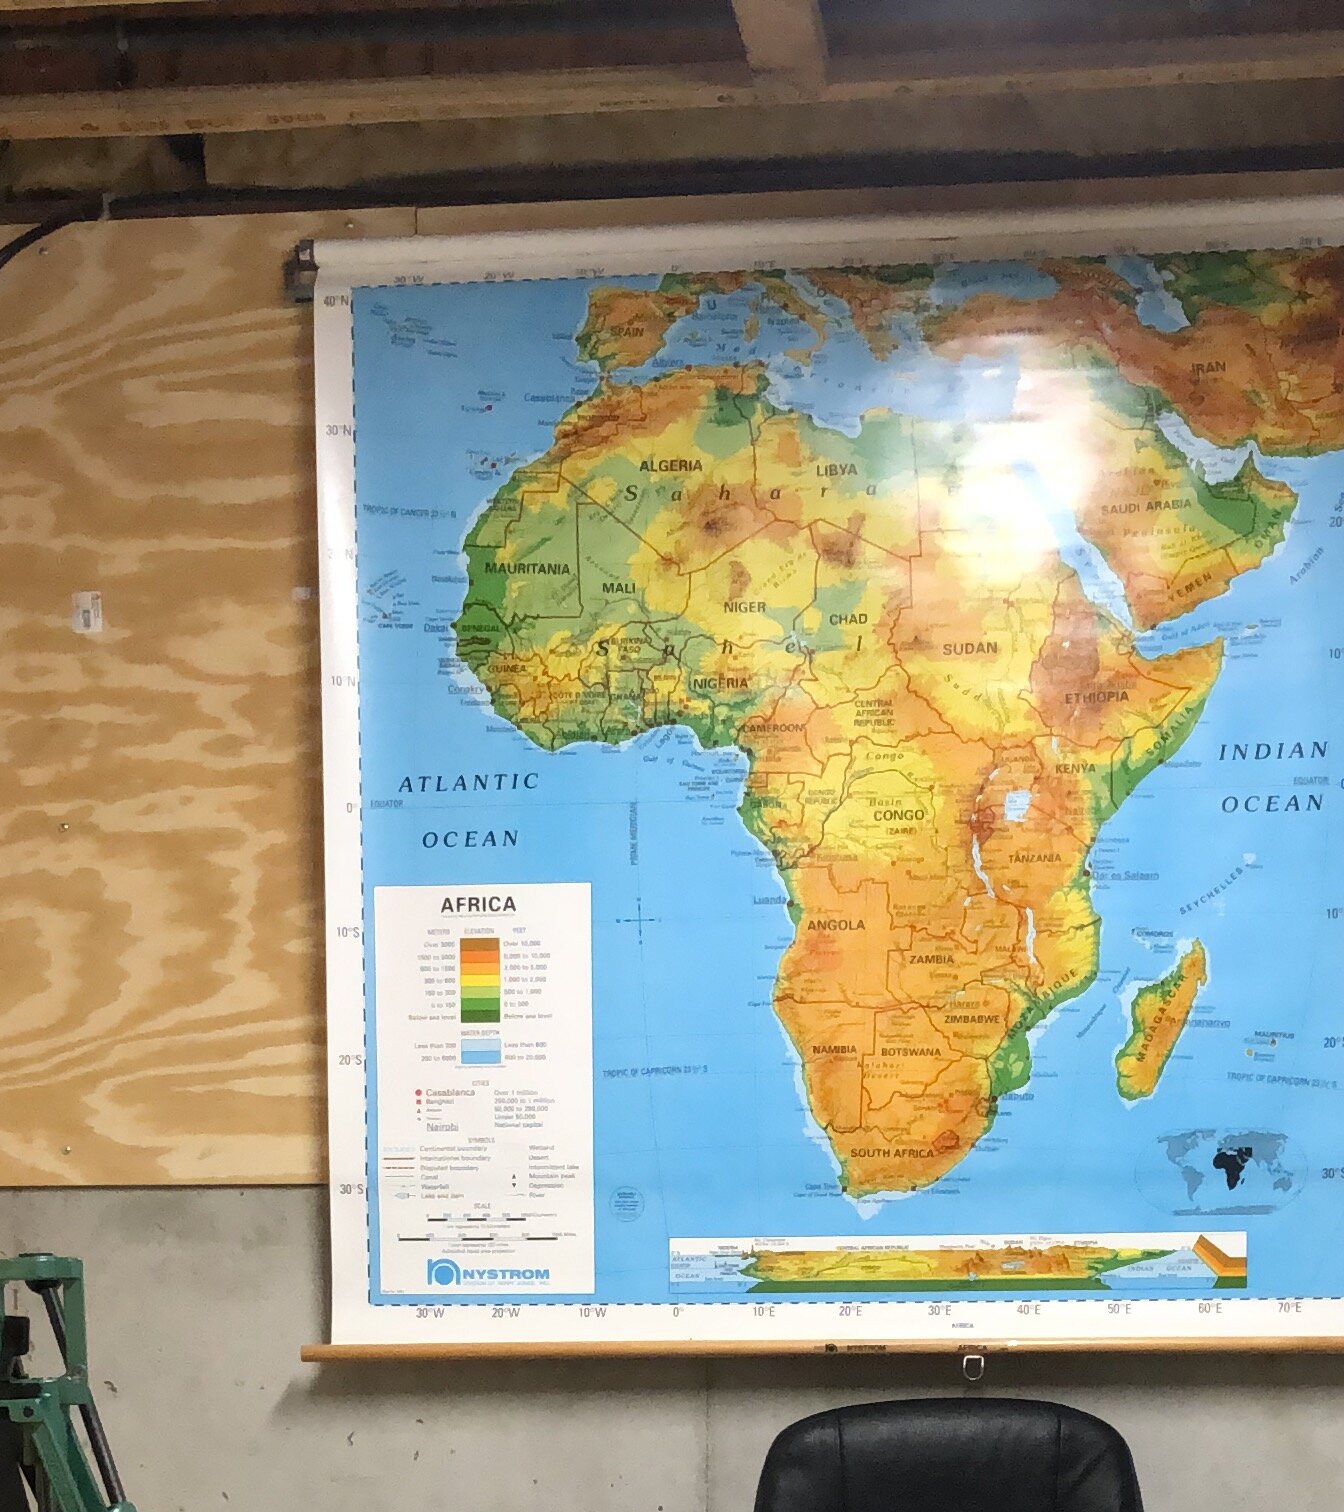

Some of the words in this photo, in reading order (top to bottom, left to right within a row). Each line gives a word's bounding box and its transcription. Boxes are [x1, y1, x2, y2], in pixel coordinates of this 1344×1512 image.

[323, 295, 349, 307] 40°N
[610, 327, 644, 337] SPAIN
[1191, 360, 1226, 375] IRAN
[326, 425, 352, 436] 30°N
[640, 460, 702, 472] ALGERIA
[816, 464, 858, 476] LIBYA
[390, 506, 399, 515] OF
[1102, 504, 1140, 514] SAUDI
[1145, 499, 1192, 511] ARABIA
[1254, 509, 1282, 549] OMAN
[485, 562, 570, 575] MAURITANIA
[1289, 546, 1324, 585] Arabian
[602, 582, 636, 594] MALI
[1168, 572, 1212, 602] YEMEN
[724, 602, 766, 612] NIGER
[829, 614, 868, 624] CHAD
[942, 642, 998, 657] SUDAN
[693, 678, 749, 690] NIGERIA
[1065, 691, 1129, 705] ETHIOPIA
[742, 723, 805, 733] CAMEROON
[854, 719, 895, 727] REPUBLIC
[1145, 705, 1194, 756] SOMALIA
[866, 752, 904, 761] Congo
[1219, 741, 1329, 762] INDIAN
[1055, 763, 1096, 774] KENYA
[398, 772, 540, 793] ATLANTIC
[869, 798, 902, 807] Basin
[1222, 795, 1324, 813] OCEAN
[873, 810, 925, 821] CONGO
[422, 830, 519, 848] OCEAN
[1008, 853, 1062, 864] TANZANIA
[1180, 867, 1243, 915] SEYCHELLES
[441, 896, 517, 913] AFRICA
[808, 920, 865, 931] ANGOLA
[336, 927, 360, 938] 10°S
[909, 955, 954, 965] ZAMBIA
[1008, 968, 1078, 1040] MOZABIQUE
[944, 1014, 1000, 1024] ZIMBABWE
[1136, 973, 1188, 1063] MADAGASCAR
[812, 1045, 857, 1055] NAMIBIA
[881, 1047, 941, 1057] BOTSWANA
[338, 1055, 362, 1066] 20°S
[603, 1070, 628, 1078] TROPIC
[630, 1069, 639, 1077] OF
[426, 1088, 476, 1097] Casablanca
[427, 1122, 459, 1131] Nairobi
[851, 1149, 890, 1158] SOUTH
[893, 1148, 934, 1158] AFRICA
[339, 1184, 364, 1195] 30°S
[463, 1269, 550, 1280] NYSTROM
[416, 1307, 445, 1319] 30°W
[492, 1306, 520, 1318] 20°W
[579, 1306, 607, 1318] 10°W
[673, 1306, 684, 1317] 0°
[753, 1306, 775, 1317] 10°E
[839, 1306, 862, 1317] 20°E
[928, 1305, 951, 1316] 30°E
[1017, 1303, 1041, 1315] 40°E
[1107, 1303, 1132, 1314] 50°E
[1198, 1302, 1222, 1314] 60°E
[1278, 1302, 1302, 1313] 70°E
